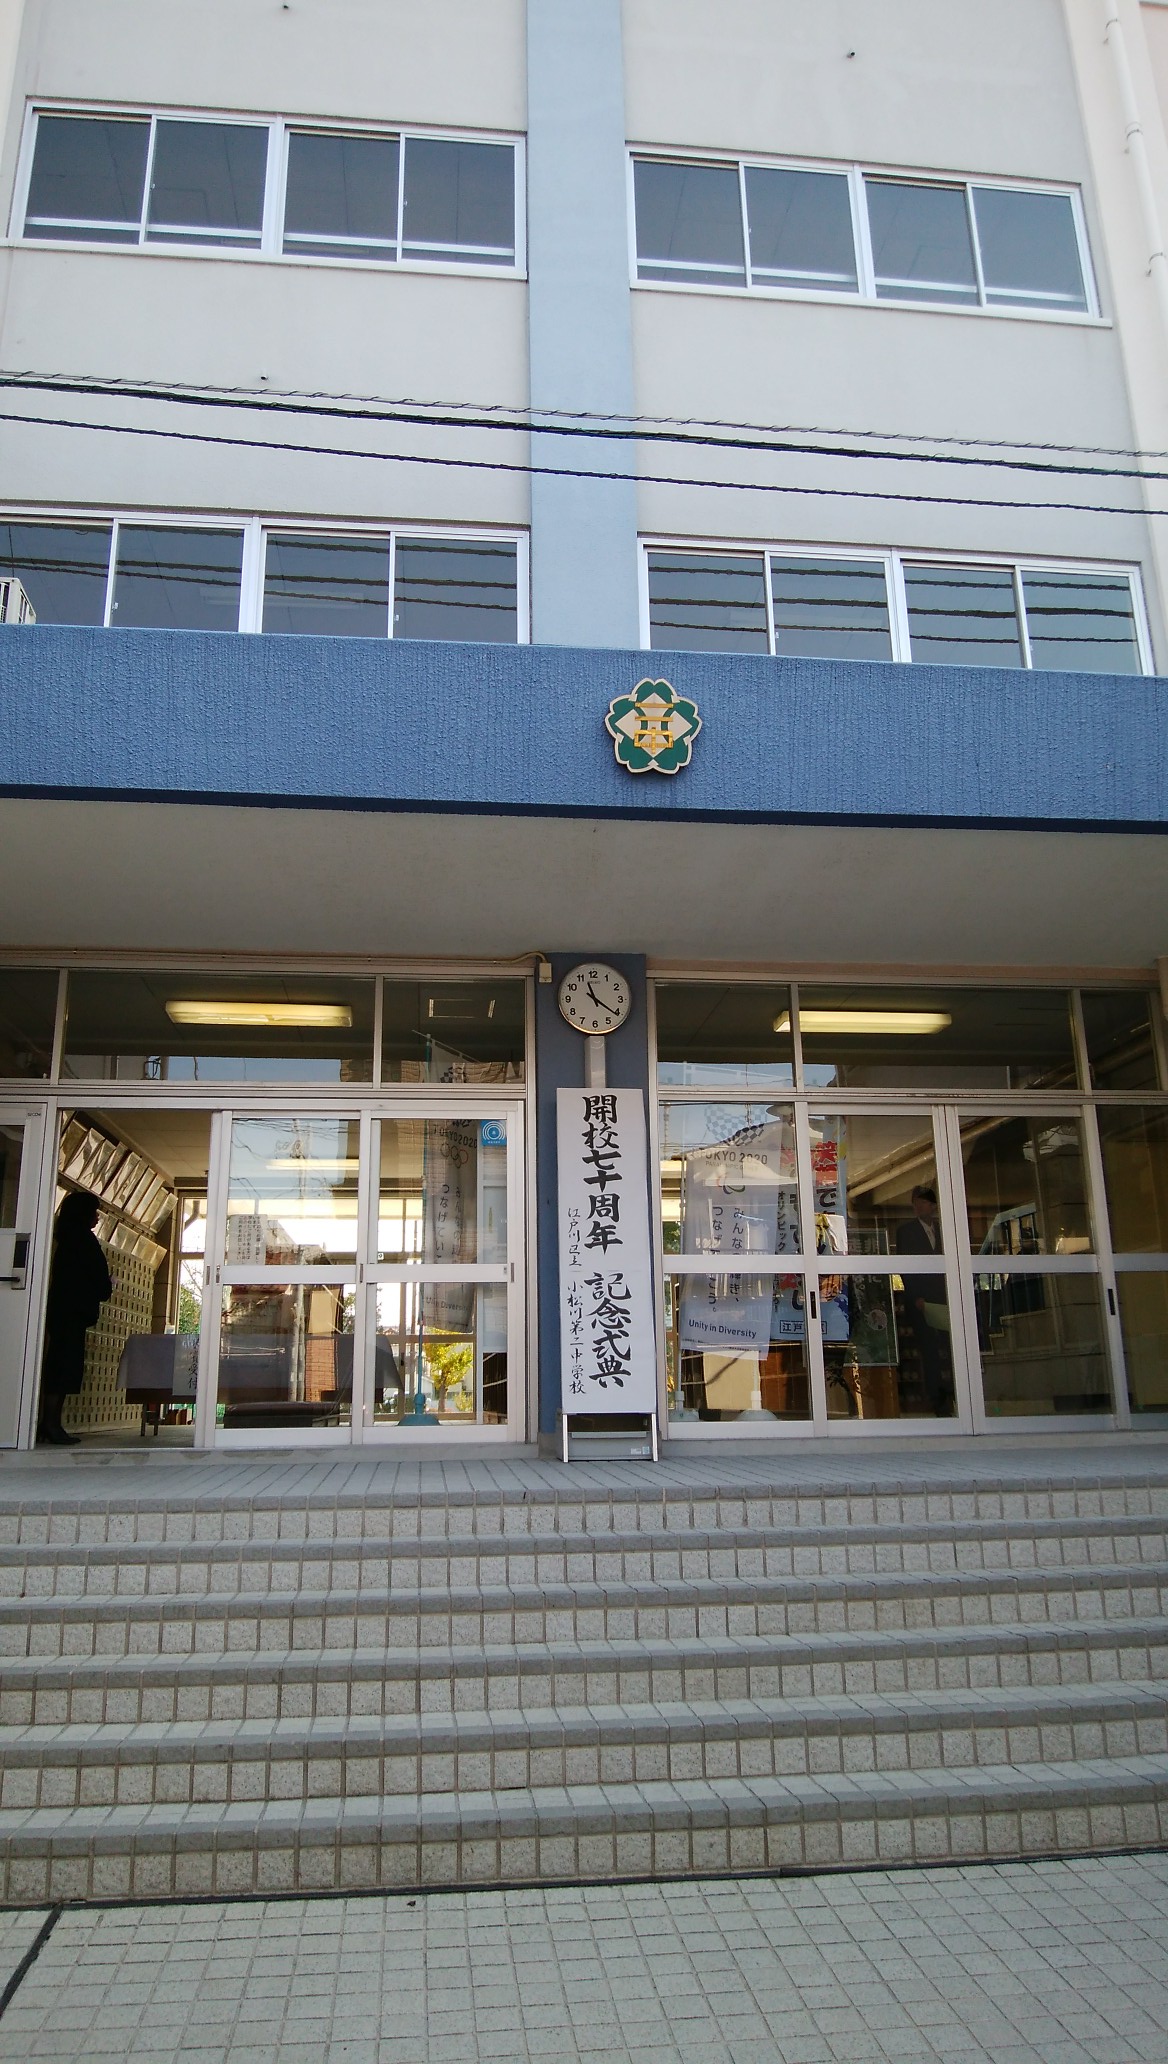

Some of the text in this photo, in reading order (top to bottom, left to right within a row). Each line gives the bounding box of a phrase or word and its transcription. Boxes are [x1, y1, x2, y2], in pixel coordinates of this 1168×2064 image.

[576, 974, 585, 982] 11
[588, 970, 598, 979] 12
[604, 974, 609, 982] 1
[567, 983, 578, 991] 10
[613, 983, 620, 991] 2
[565, 995, 572, 1004] 9
[617, 995, 624, 1004] 3
[569, 1007, 576, 1016] 8
[614, 1007, 621, 1016] 4
[579, 1017, 586, 1025] 7
[592, 1020, 599, 1028] 6
[605, 1017, 612, 1025] 5
[701, 1149, 736, 1162] OKYO
[581, 1094, 632, 1388] 開校七十周年 記念式典
[688, 1319, 757, 1339] Unity in Diversity
